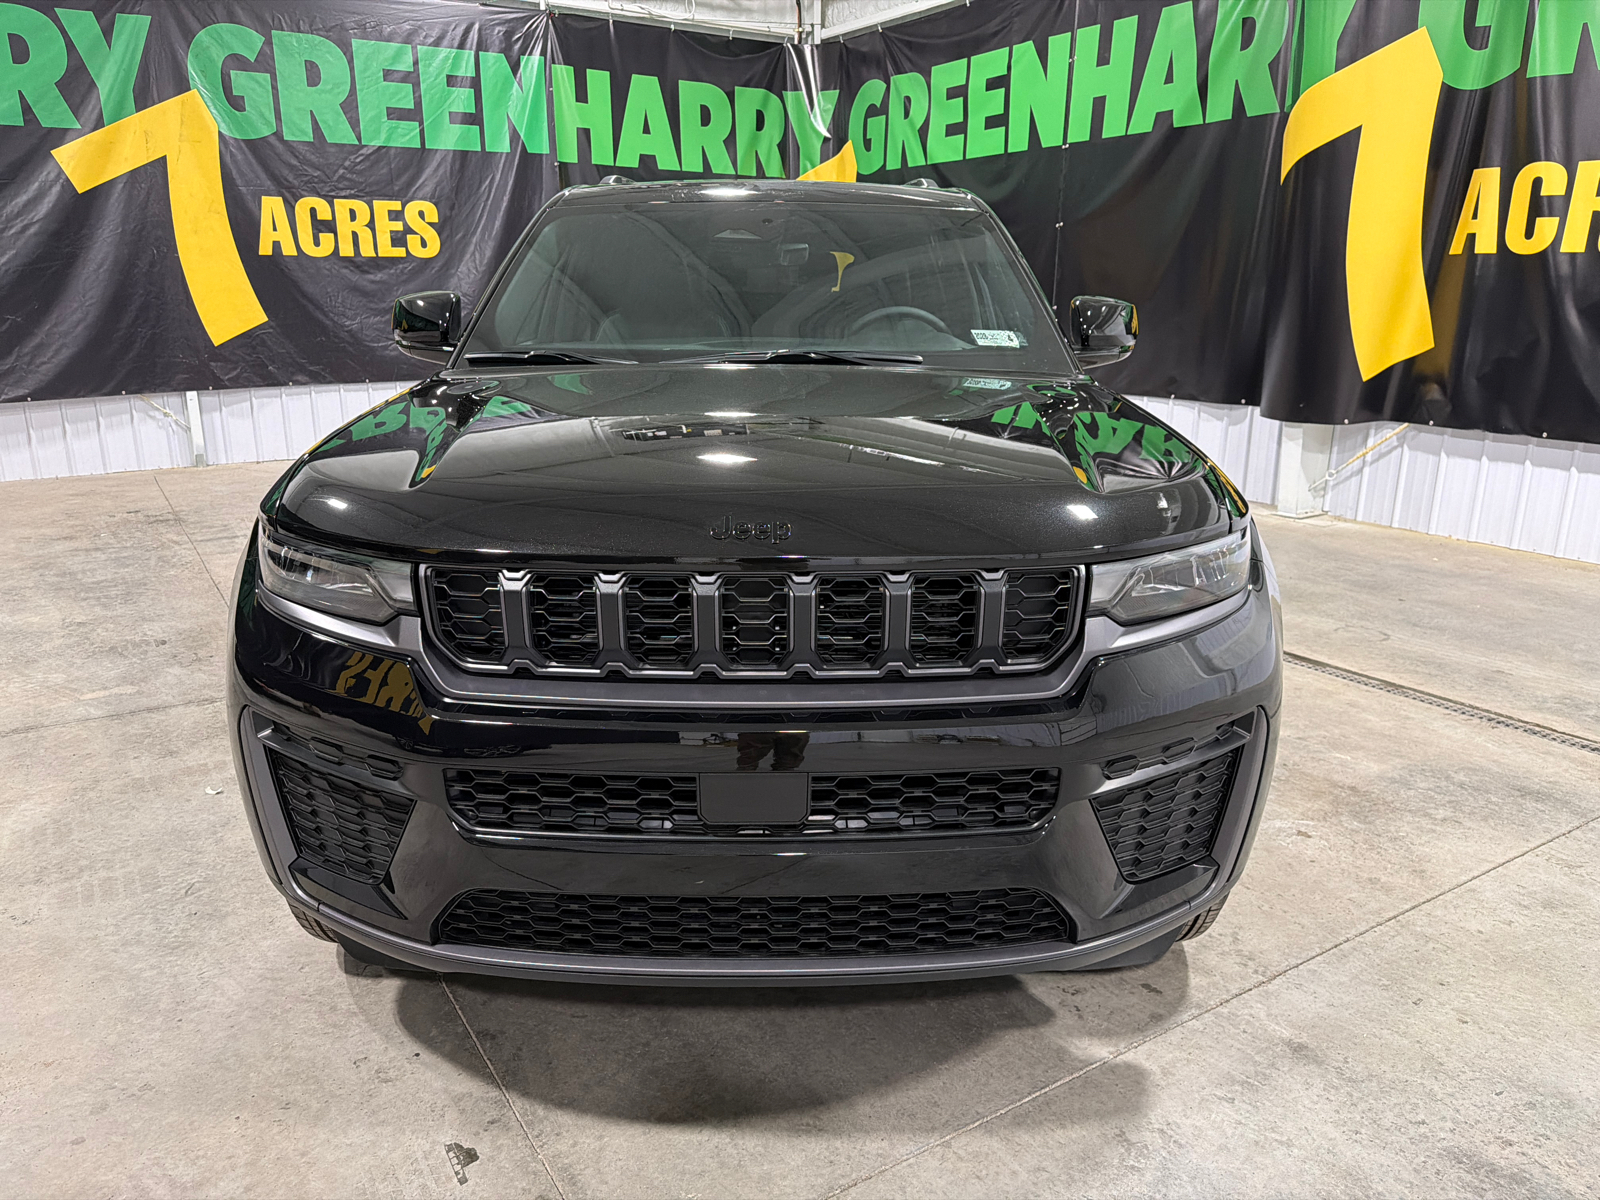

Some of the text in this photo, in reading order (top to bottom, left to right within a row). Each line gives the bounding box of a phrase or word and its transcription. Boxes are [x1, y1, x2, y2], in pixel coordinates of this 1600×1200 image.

[187, 22, 550, 154] GREEN
[551, 31, 1072, 178] HARRY GREEN
[51, 88, 441, 346] 7 ACRES
[1280, 26, 1444, 382] 7
[709, 515, 792, 544] Jeep
